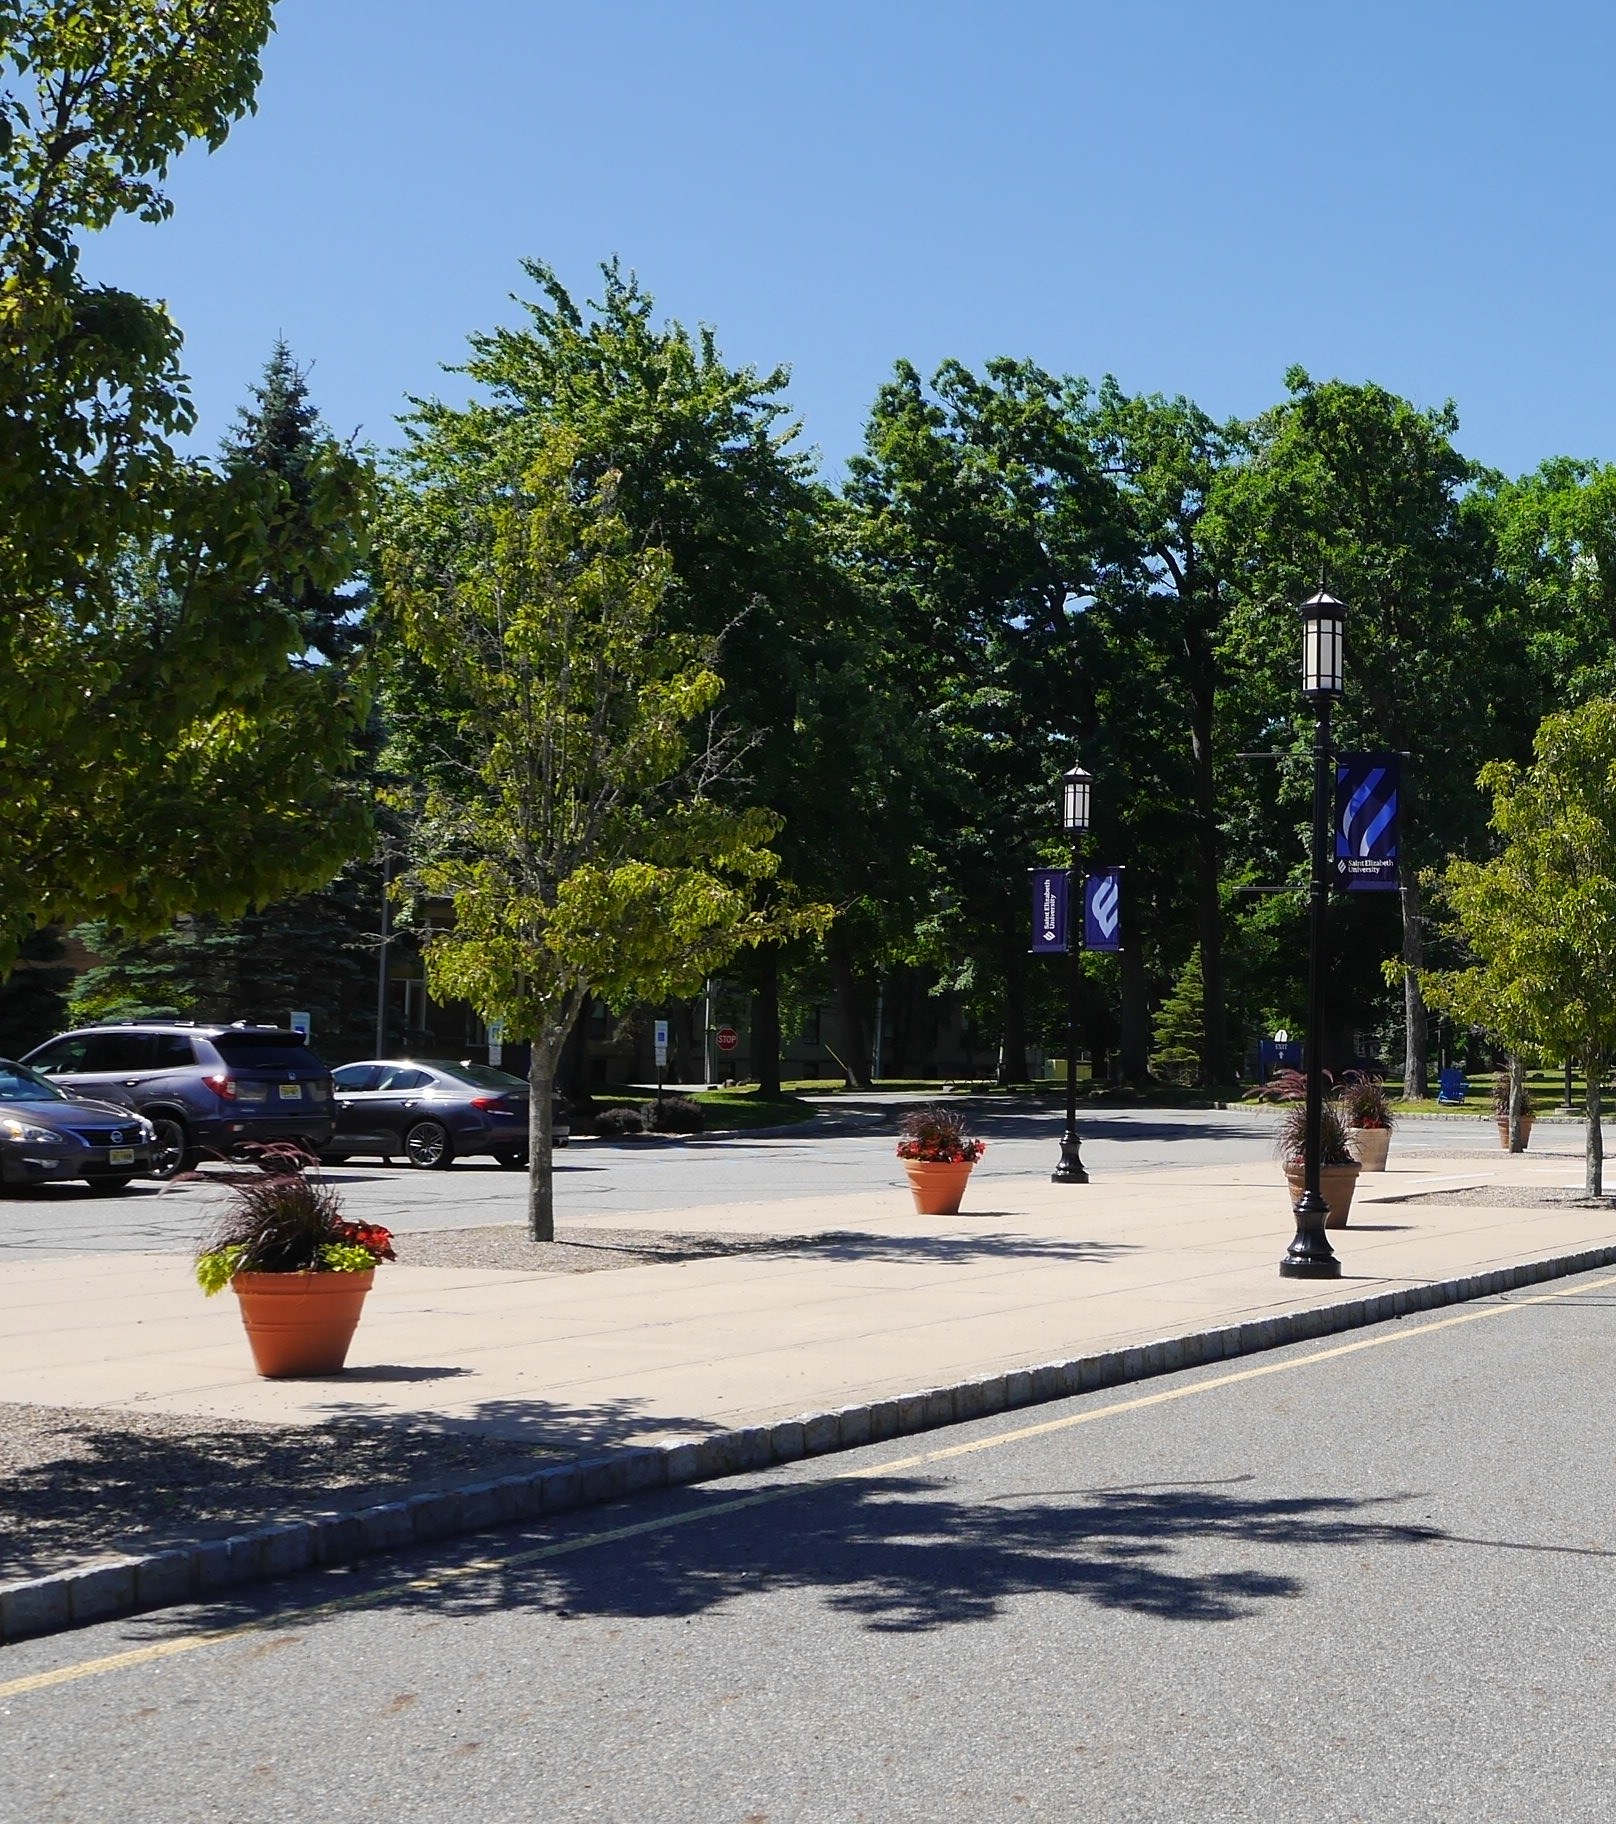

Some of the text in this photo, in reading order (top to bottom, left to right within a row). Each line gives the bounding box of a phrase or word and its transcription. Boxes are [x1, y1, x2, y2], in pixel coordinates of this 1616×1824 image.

[1365, 859, 1394, 867] Elizabeth
[1348, 866, 1380, 874] University
[718, 1035, 736, 1043] STOP
